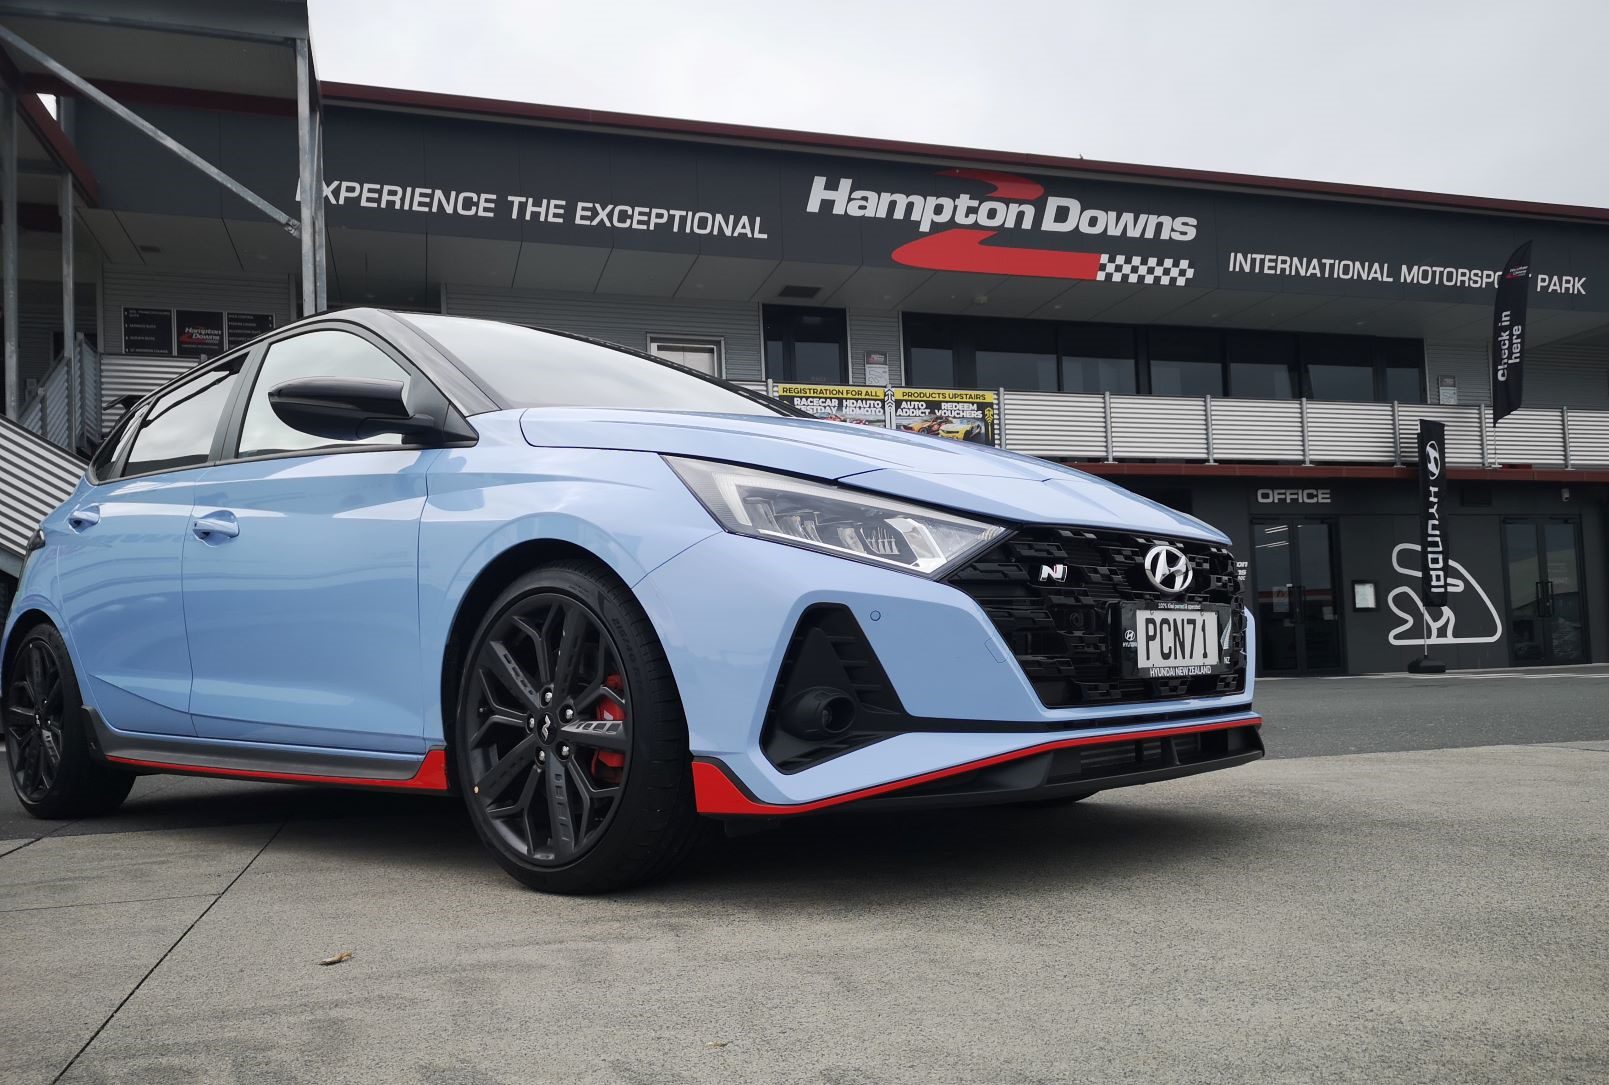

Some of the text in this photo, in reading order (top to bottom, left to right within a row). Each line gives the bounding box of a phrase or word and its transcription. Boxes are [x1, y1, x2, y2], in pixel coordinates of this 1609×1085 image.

[295, 178, 769, 239] XPERIENCE THE EXCEPTIONAL
[806, 176, 1198, 241] Hampton Downs
[1229, 252, 1393, 282] INTERNATIONAL
[1400, 264, 1533, 289] MOTORSP
[1536, 274, 1587, 295] PARK
[1497, 310, 1511, 382] Check in
[1507, 325, 1522, 364] here
[782, 387, 880, 398] REGISTRATION FOR ALL
[902, 391, 986, 401] PRODUCTS UPSTAIRS
[793, 397, 839, 407] RACECAR
[843, 400, 882, 408] HDAUTO
[900, 401, 926, 409] AUTO
[941, 402, 978, 411] REDEEM
[842, 407, 884, 416] HDMOTO
[896, 409, 930, 417] ADDICT
[935, 410, 983, 419] VOUCHERS
[1257, 488, 1331, 503] OFFICE
[1427, 486, 1445, 593] HYUNDAI
[1144, 617, 1208, 661] PCN71
[1223, 656, 1231, 664] NZ
[1150, 665, 1212, 678] HYUNDAI NEW ZEALAND
